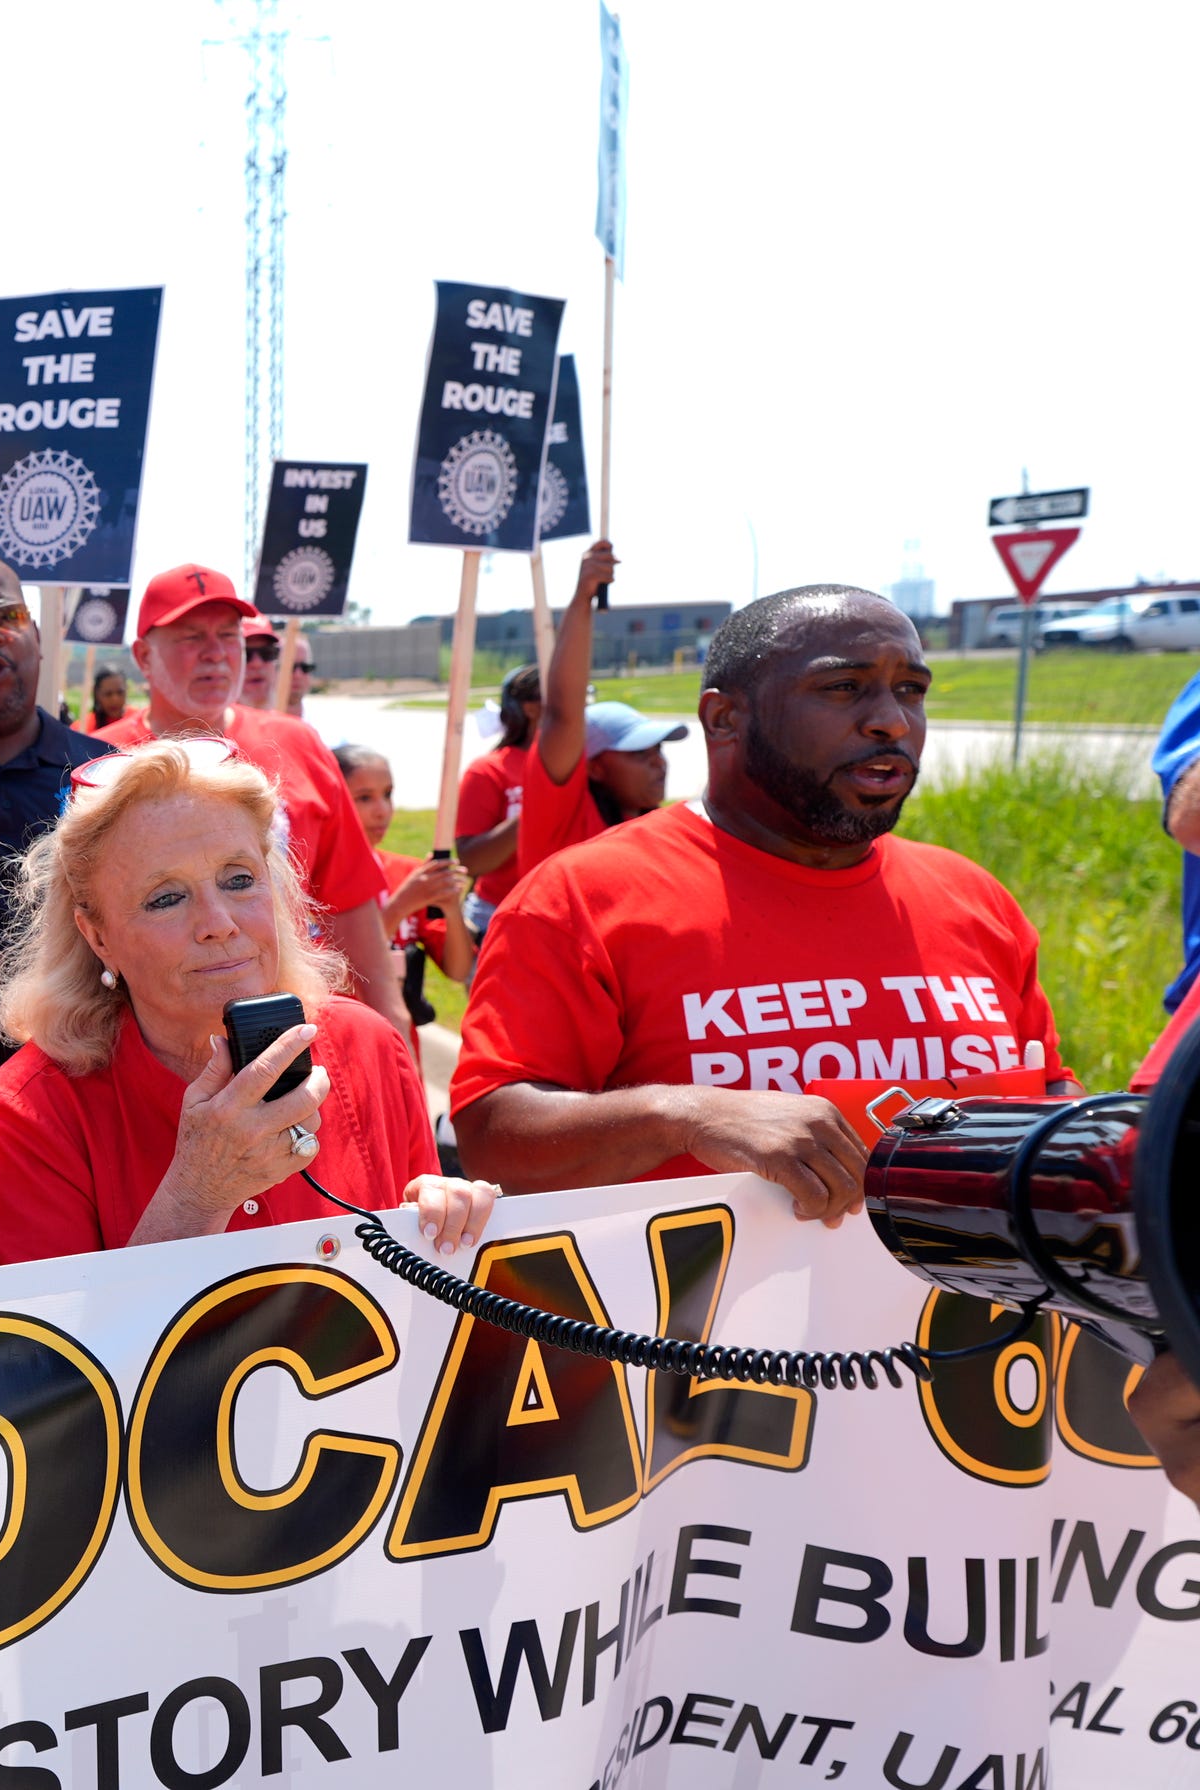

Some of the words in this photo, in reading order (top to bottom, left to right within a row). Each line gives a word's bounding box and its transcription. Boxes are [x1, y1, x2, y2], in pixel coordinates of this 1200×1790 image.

[14, 306, 115, 342] SAVE
[466, 299, 535, 337] SAVE
[22, 353, 96, 385] THE
[471, 342, 522, 376] THE
[441, 381, 536, 419] ROUGE
[283, 468, 357, 489] INVEST
[20, 496, 67, 521] UAW
[304, 494, 329, 513] IN
[298, 518, 328, 538] US
[682, 977, 868, 1041] KEEP
[880, 975, 1007, 1023] THE
[690, 1034, 1020, 1094] PROMISE
[459, 1524, 752, 1735] WHILE
